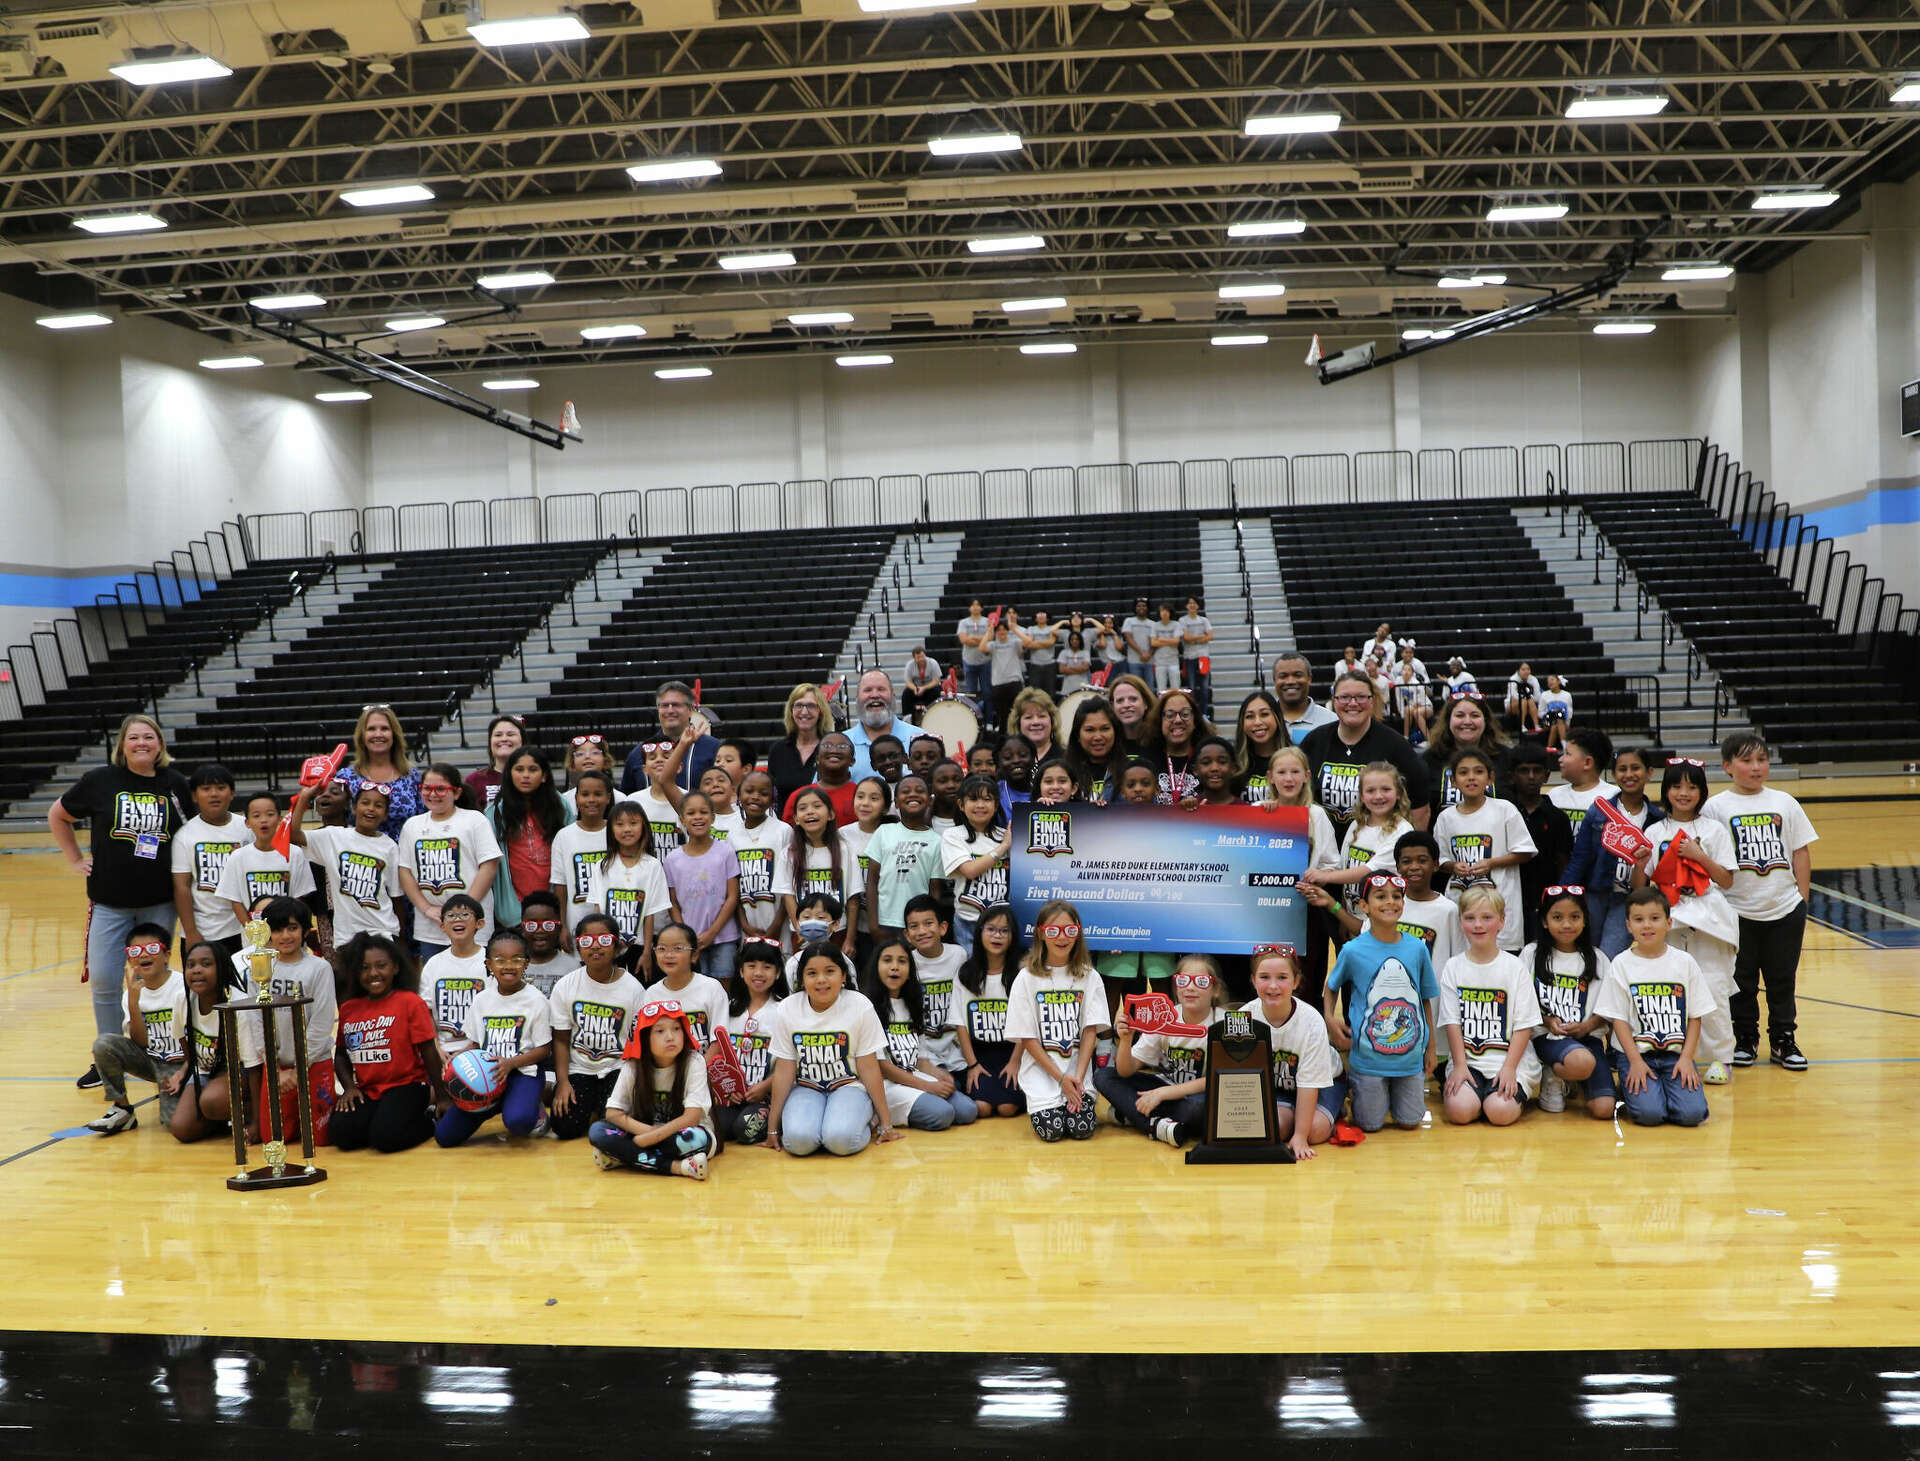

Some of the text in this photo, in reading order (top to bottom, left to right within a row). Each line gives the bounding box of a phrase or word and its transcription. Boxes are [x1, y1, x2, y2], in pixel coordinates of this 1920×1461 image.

[1331, 768, 1357, 776] READ
[1566, 810, 1585, 820] EAD
[1742, 815, 1771, 826] READ
[1034, 821, 1066, 834] FINAL
[1034, 833, 1066, 846] FOUR
[1736, 826, 1780, 843] FINAL
[423, 840, 449, 850] READ
[1218, 835, 1246, 845] March
[1268, 839, 1293, 848] 2023
[1456, 837, 1480, 847] READ
[204, 844, 232, 853] READ
[1740, 843, 1782, 860] FOUR
[349, 854, 376, 867] READ
[419, 848, 456, 864] FINAL
[738, 852, 763, 861] READ
[1085, 861, 1110, 869] JAMES
[1111, 862, 1126, 870] RED
[1128, 862, 1150, 870] DUKE
[1150, 862, 1199, 871] ELEMENTARY
[1200, 863, 1229, 872] SCHOOL
[254, 873, 282, 882] READ
[342, 862, 378, 883] FINAL
[420, 864, 457, 882] FOUR
[1078, 872, 1222, 883] ALVIN INDEPENDENT SCHOOL DISTRICT
[740, 877, 770, 892] FOUR
[1253, 876, 1294, 886] 5,000.00
[250, 882, 287, 896] FINAL
[1027, 886, 1049, 898] Five
[1052, 887, 1104, 899] Thousand
[1106, 888, 1144, 900] Dollars
[1258, 898, 1292, 906] DOLLARS
[1112, 926, 1151, 938] Champion
[446, 980, 473, 990] READ
[926, 984, 952, 994] READ
[1638, 985, 1671, 996] READ
[1045, 993, 1075, 1004] READ
[1463, 990, 1494, 1002] READ
[583, 1004, 612, 1016] READ
[1635, 996, 1680, 1015] FINAL
[439, 1005, 470, 1022] FOU
[376, 1016, 396, 1028] DAY
[488, 1019, 515, 1028] READ
[576, 1013, 616, 1033] FINAL
[973, 1012, 1006, 1029] FINA
[1228, 1016, 1250, 1024] FINAL
[1228, 1025, 1250, 1034] FOUR
[803, 1035, 834, 1046] READ
[366, 1051, 389, 1062] Like
[797, 1045, 840, 1063] FINAL
